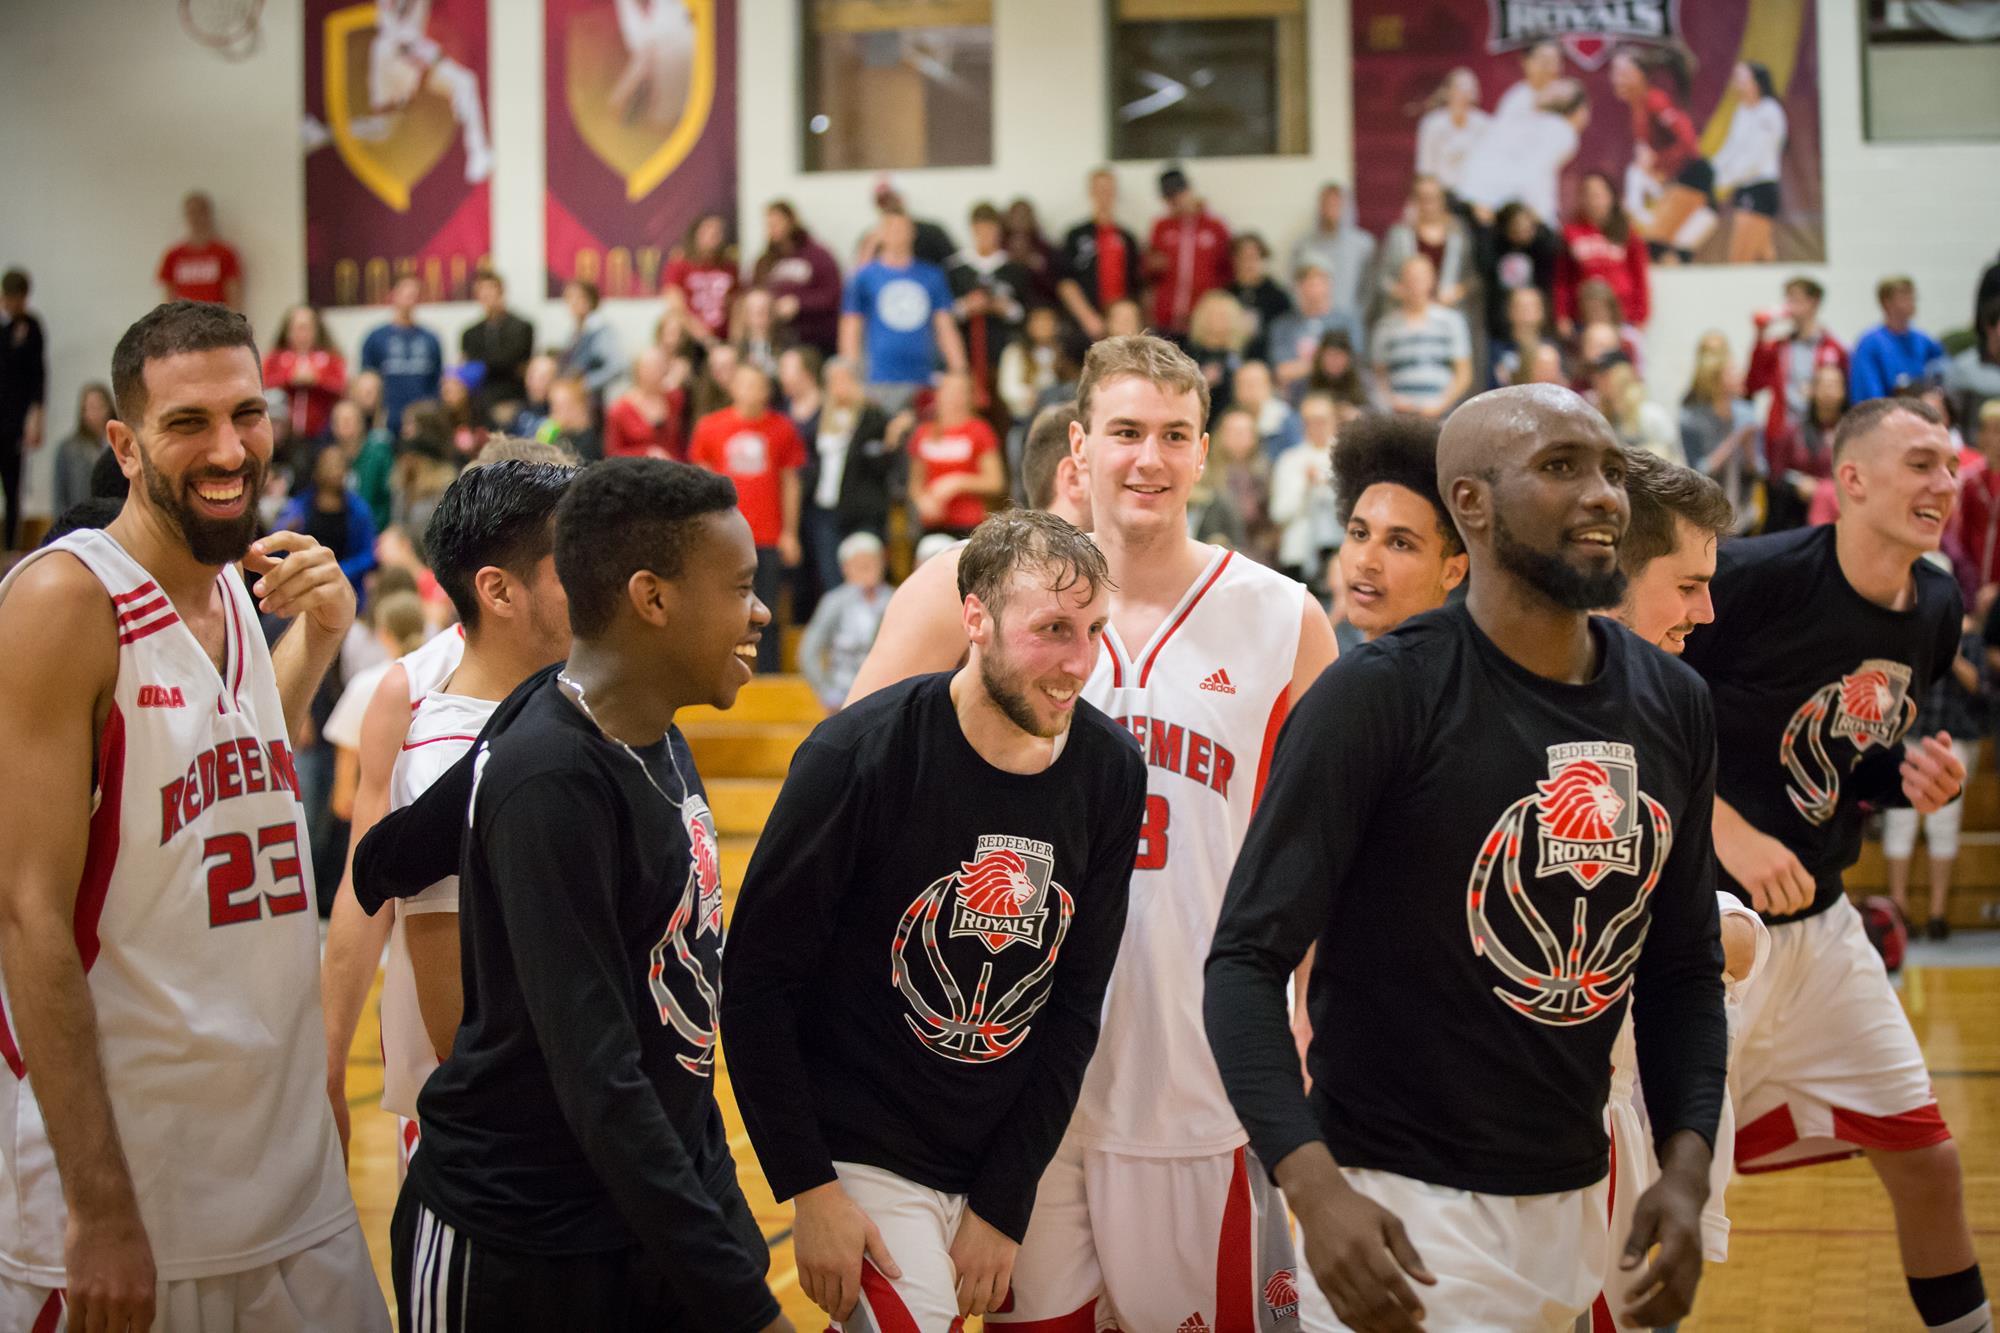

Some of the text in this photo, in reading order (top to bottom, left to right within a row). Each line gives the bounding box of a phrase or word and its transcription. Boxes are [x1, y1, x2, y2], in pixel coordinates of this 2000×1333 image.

[1199, 681, 1236, 695] adidas
[1549, 744, 1633, 761] REDEEMER
[979, 836, 1052, 858] REDEEMER
[1548, 839, 1632, 865] ROYALS
[202, 822, 308, 928] 23
[960, 909, 1035, 936] ROYALS
